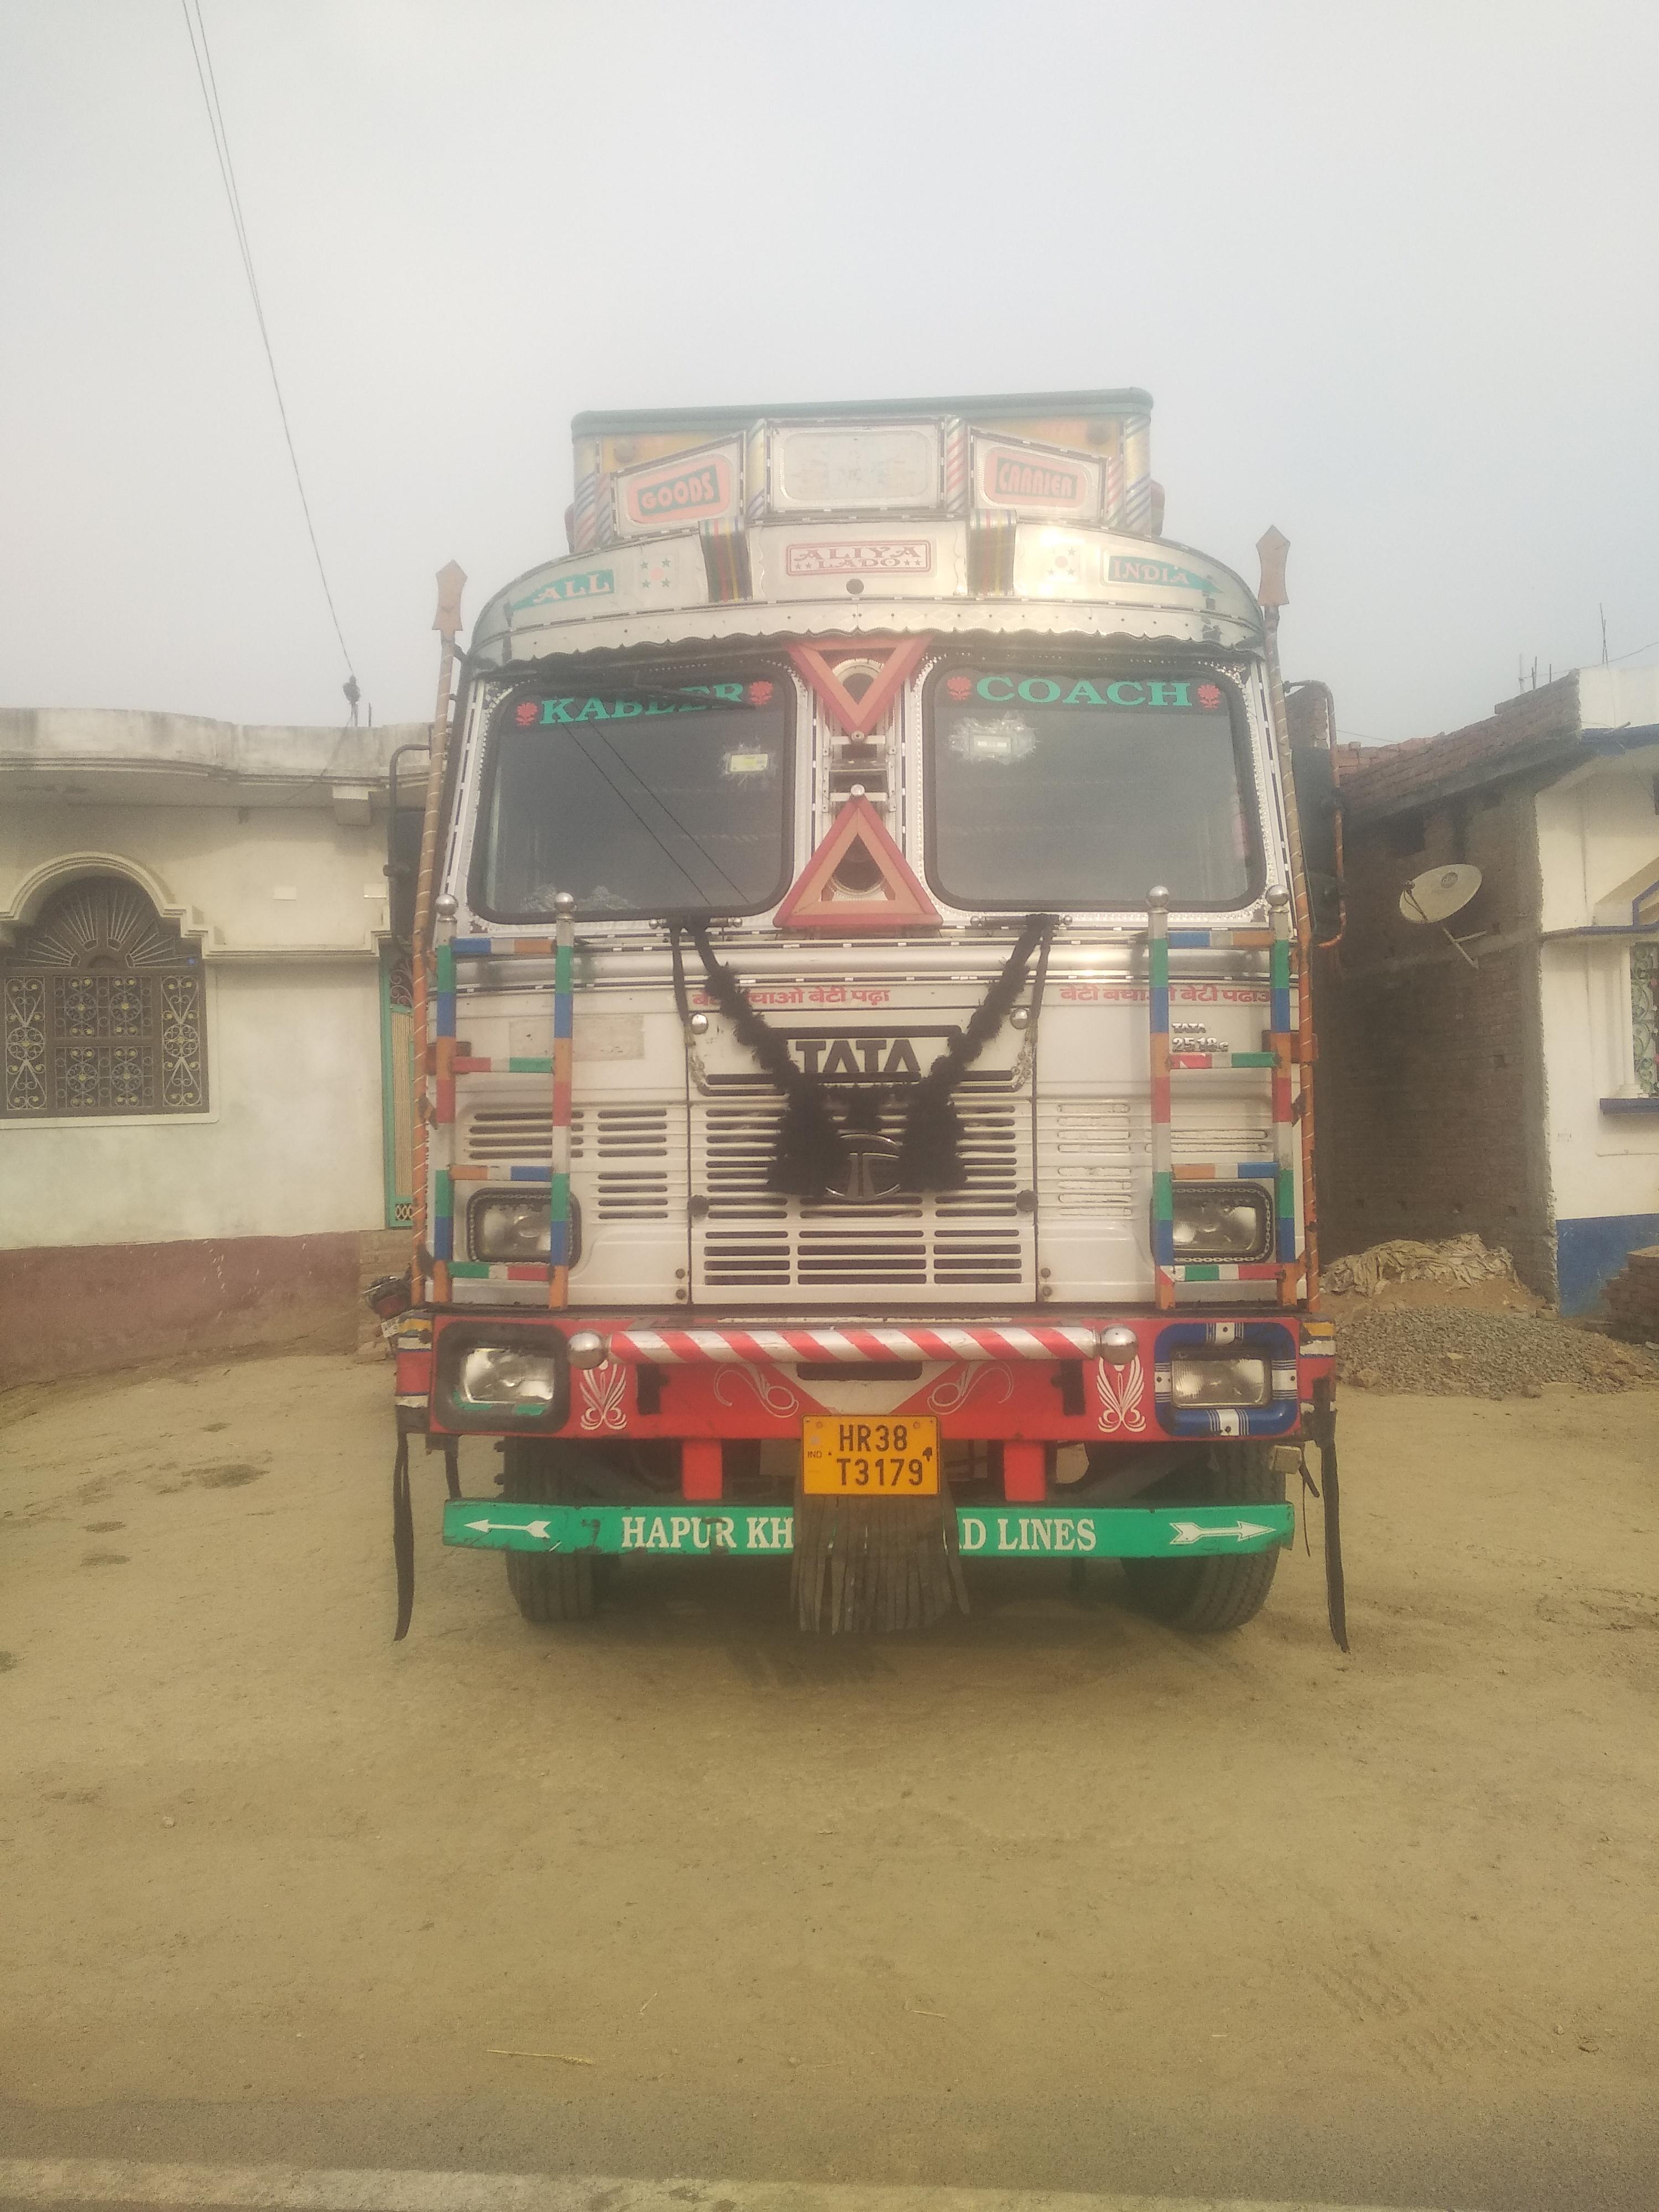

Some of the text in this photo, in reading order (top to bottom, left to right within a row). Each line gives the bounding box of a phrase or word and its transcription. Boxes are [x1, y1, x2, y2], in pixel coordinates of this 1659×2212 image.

[641, 471, 714, 509] GOODS
[999, 462, 1072, 497] CARRIER
[794, 545, 921, 561] ALIYA
[818, 558, 900, 568] LADO
[1114, 560, 1188, 584] INDIA
[533, 574, 610, 603] ALL
[977, 676, 1192, 706] COACH
[1172, 1022, 1206, 1033] TATA
[796, 1039, 921, 1073] TATA
[839, 1425, 907, 1452] HR38
[837, 1458, 922, 1486] T3179
[622, 1517, 737, 1548] HAPUR
[998, 1519, 1096, 1551] LINES
